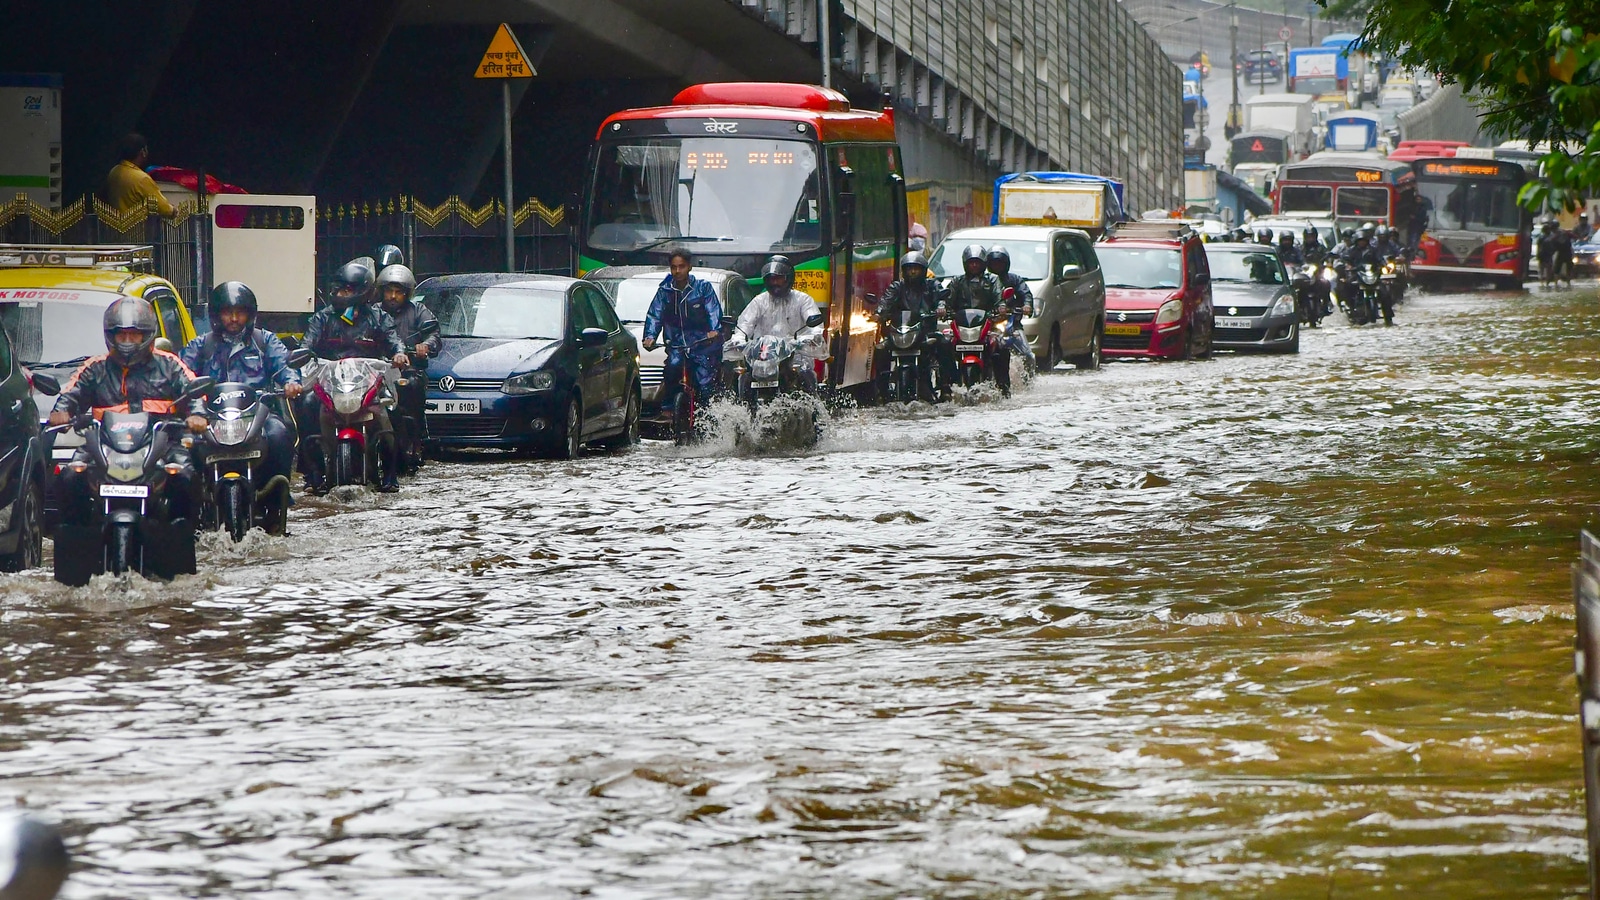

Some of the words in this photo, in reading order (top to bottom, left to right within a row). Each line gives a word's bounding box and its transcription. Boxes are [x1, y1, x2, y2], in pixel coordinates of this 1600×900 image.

[482, 61, 503, 75] हरित
[505, 61, 524, 77] मुंबई
[703, 117, 739, 133] बेस्ट
[25, 253, 61, 264] A/C
[12, 291, 80, 300] MOTORS
[445, 403, 455, 412] BY
